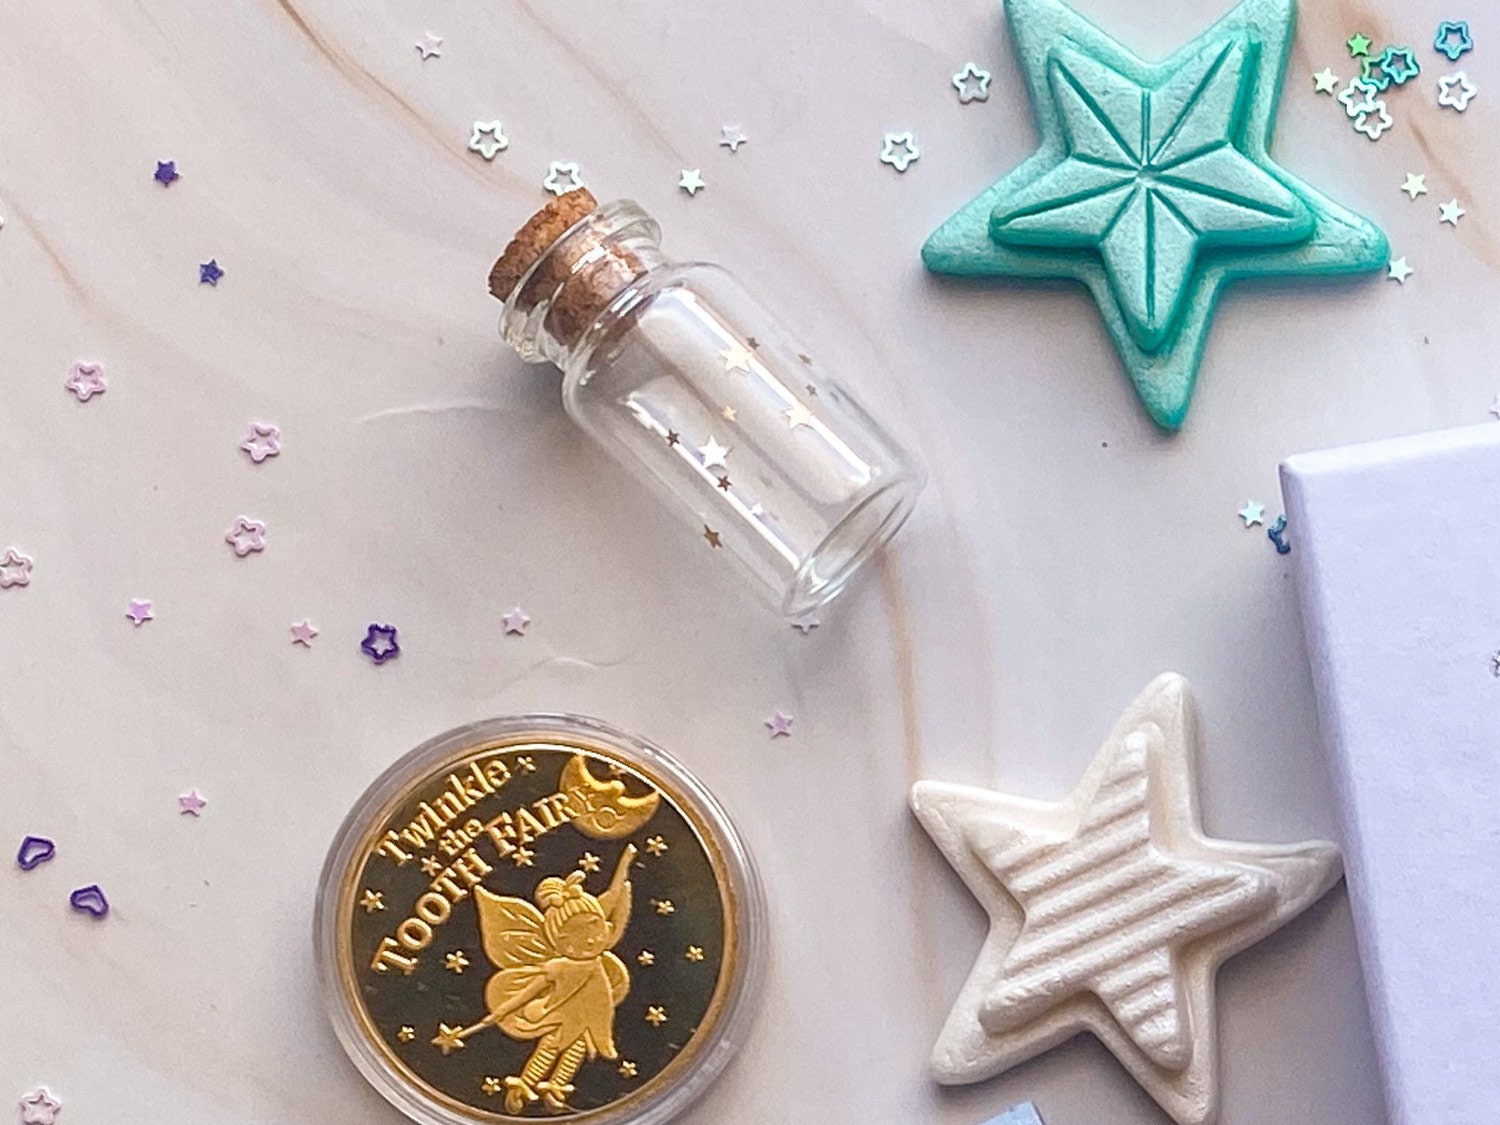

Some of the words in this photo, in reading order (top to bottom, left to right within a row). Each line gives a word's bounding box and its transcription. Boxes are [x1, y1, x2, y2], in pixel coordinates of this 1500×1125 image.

[378, 760, 511, 866] Twinkle
[437, 818, 485, 856] the
[370, 847, 494, 976] TOOTH
